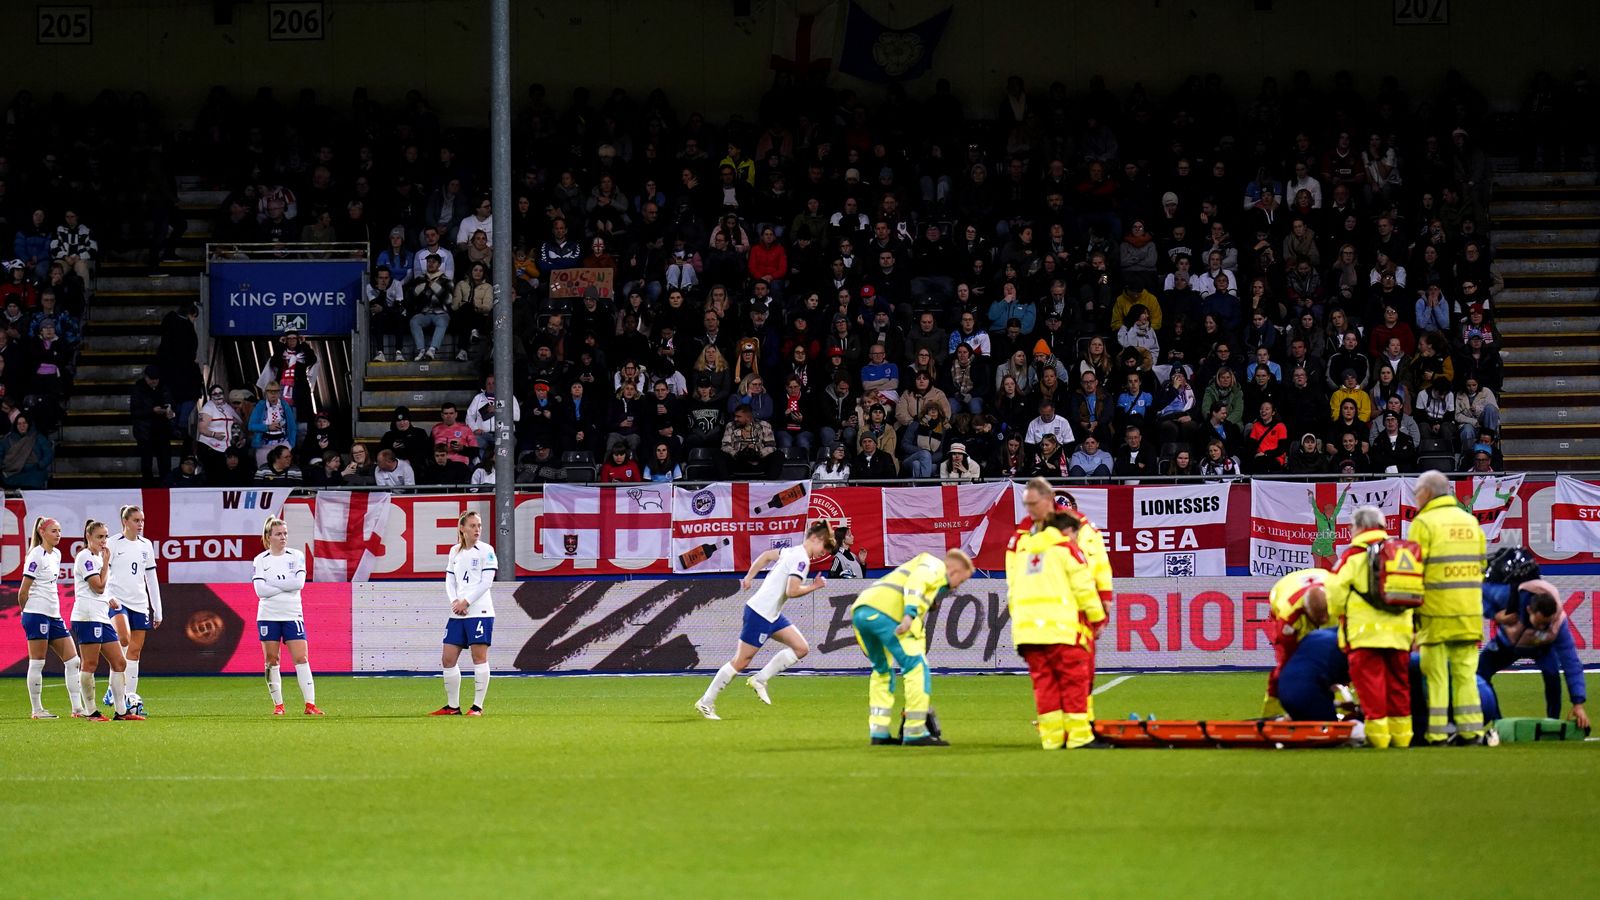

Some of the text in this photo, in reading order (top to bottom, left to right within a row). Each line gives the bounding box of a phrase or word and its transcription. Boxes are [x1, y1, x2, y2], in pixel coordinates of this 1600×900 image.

[41, 14, 87, 38] 205
[271, 9, 319, 34] 206
[230, 292, 347, 307] KING POWER
[223, 491, 274, 510] WHU
[813, 497, 839, 517] BELGIAN
[1141, 495, 1220, 516] LIONESSES
[681, 518, 799, 535] WORCESTER CITY
[934, 521, 961, 529] BRONZE
[1252, 521, 1352, 541] be unapologetically
[1100, 528, 1199, 552] ELSEA
[1257, 545, 1309, 565] UP THE
[131, 562, 138, 576] 9
[463, 570, 469, 584] 4
[1444, 564, 1481, 578] DOCTO
[476, 620, 484, 635] 4
[817, 587, 1010, 661] EJOY
